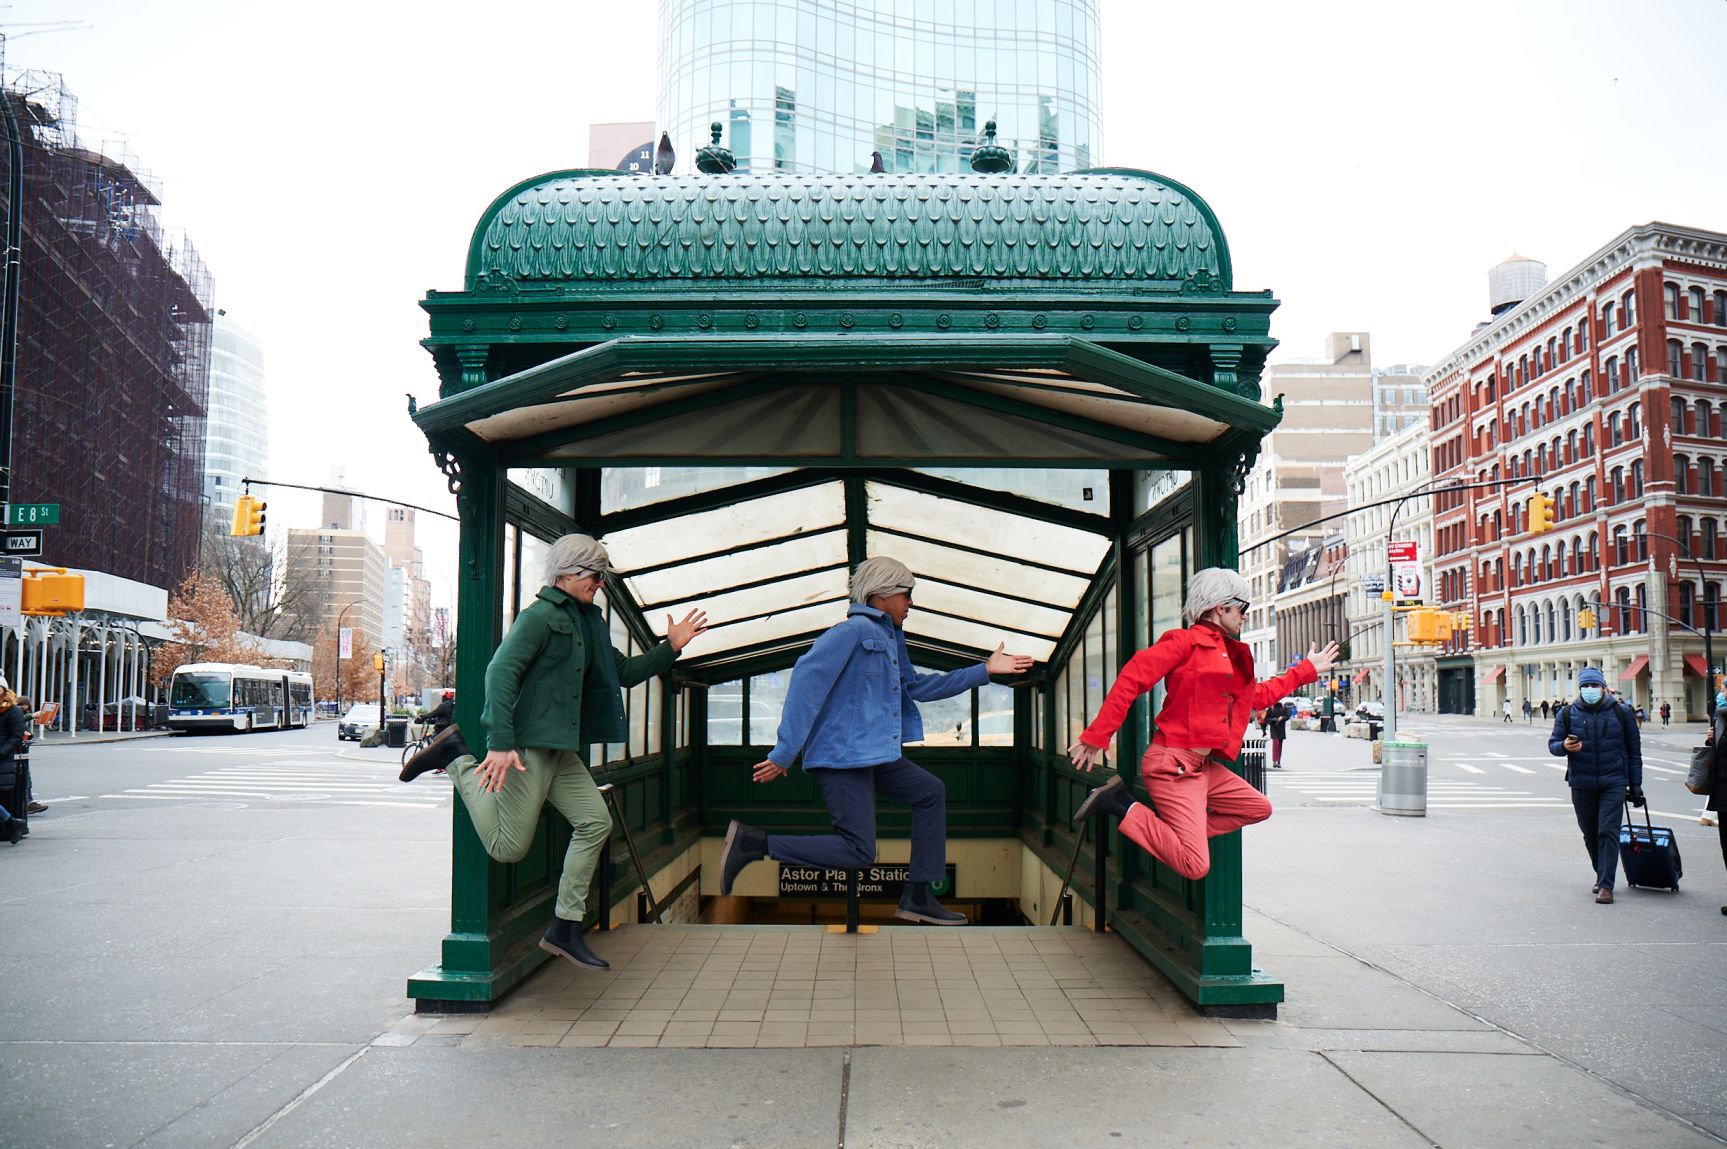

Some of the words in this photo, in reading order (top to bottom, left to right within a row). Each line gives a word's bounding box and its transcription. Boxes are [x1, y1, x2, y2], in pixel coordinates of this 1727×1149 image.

[640, 150, 650, 159] 11
[629, 162, 640, 171] 10
[18, 507, 25, 522] E
[29, 506, 37, 522] 8
[41, 506, 49, 517] St
[10, 538, 32, 548] WAY
[781, 867, 820, 880] Astor
[825, 869, 864, 881] Plae
[870, 868, 910, 881] Statio
[780, 882, 818, 893] Uptown
[821, 882, 829, 891] &
